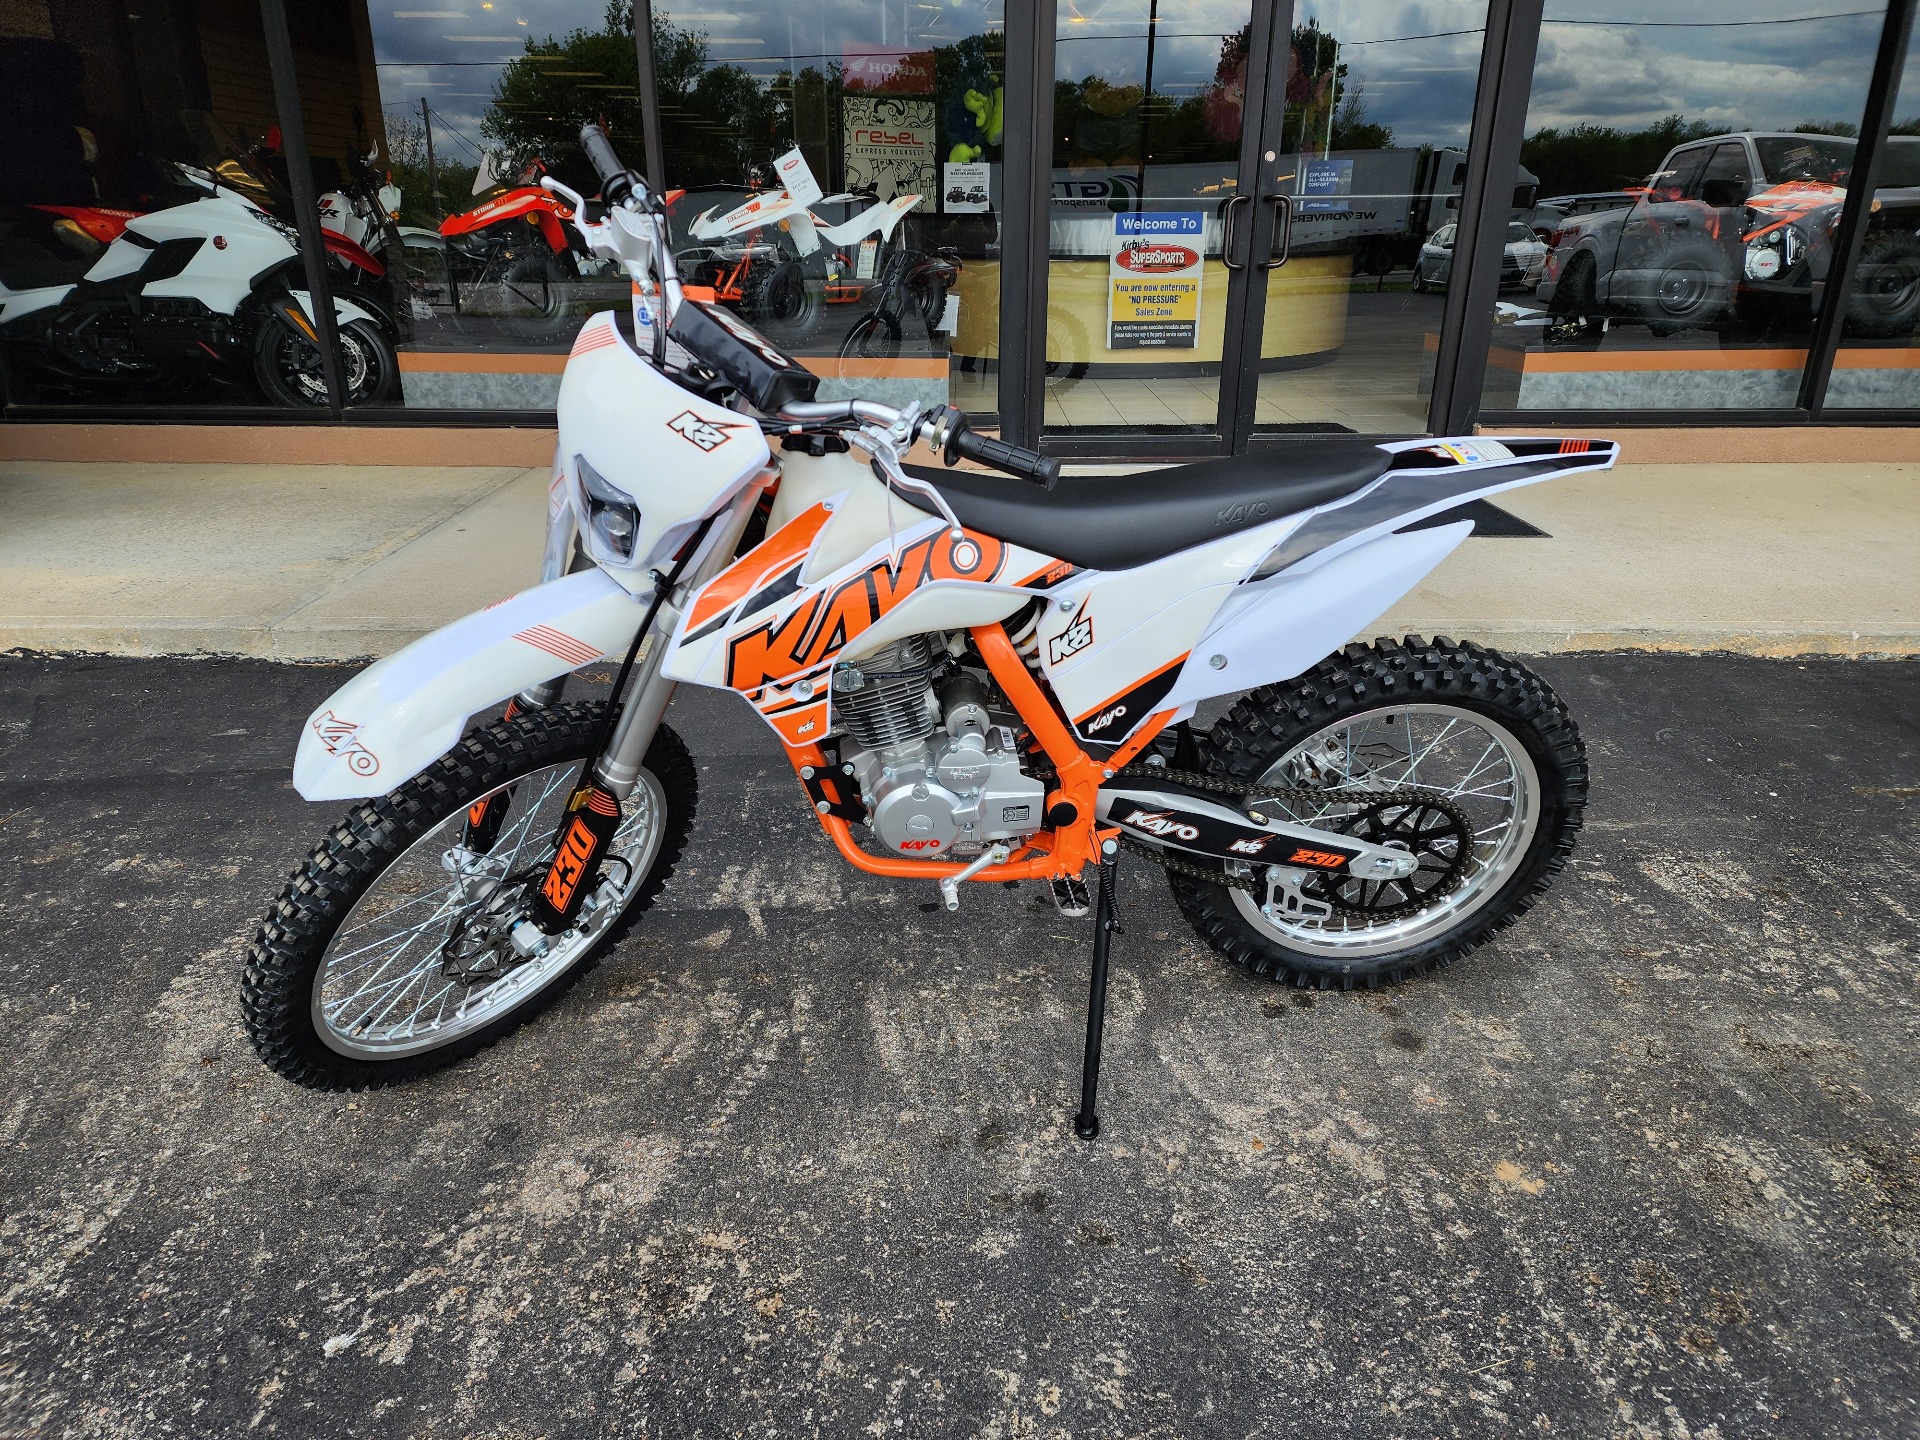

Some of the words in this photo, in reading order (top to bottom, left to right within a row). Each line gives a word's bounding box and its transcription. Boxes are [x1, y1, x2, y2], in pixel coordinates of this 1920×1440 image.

[868, 62, 927, 76] HONDA
[100, 208, 136, 218] HONDA
[1122, 218, 1178, 229] Welcome
[1180, 217, 1197, 229] To
[1121, 238, 1150, 252] Kirby's
[1115, 283, 1129, 292] You
[1130, 284, 1142, 292] are
[1160, 283, 1189, 293] entering
[1142, 294, 1181, 304] PRESSURE"
[1135, 307, 1154, 316] Sales
[1156, 307, 1173, 315] Zone
[1214, 501, 1270, 527] KAYO
[1045, 561, 1074, 586] 230
[728, 525, 1006, 700] KAYO
[1088, 704, 1127, 735] KAYO
[1122, 809, 1200, 840] KAYO
[899, 839, 941, 851] KAYO
[541, 815, 598, 914] 230
[1288, 848, 1347, 868] 230
